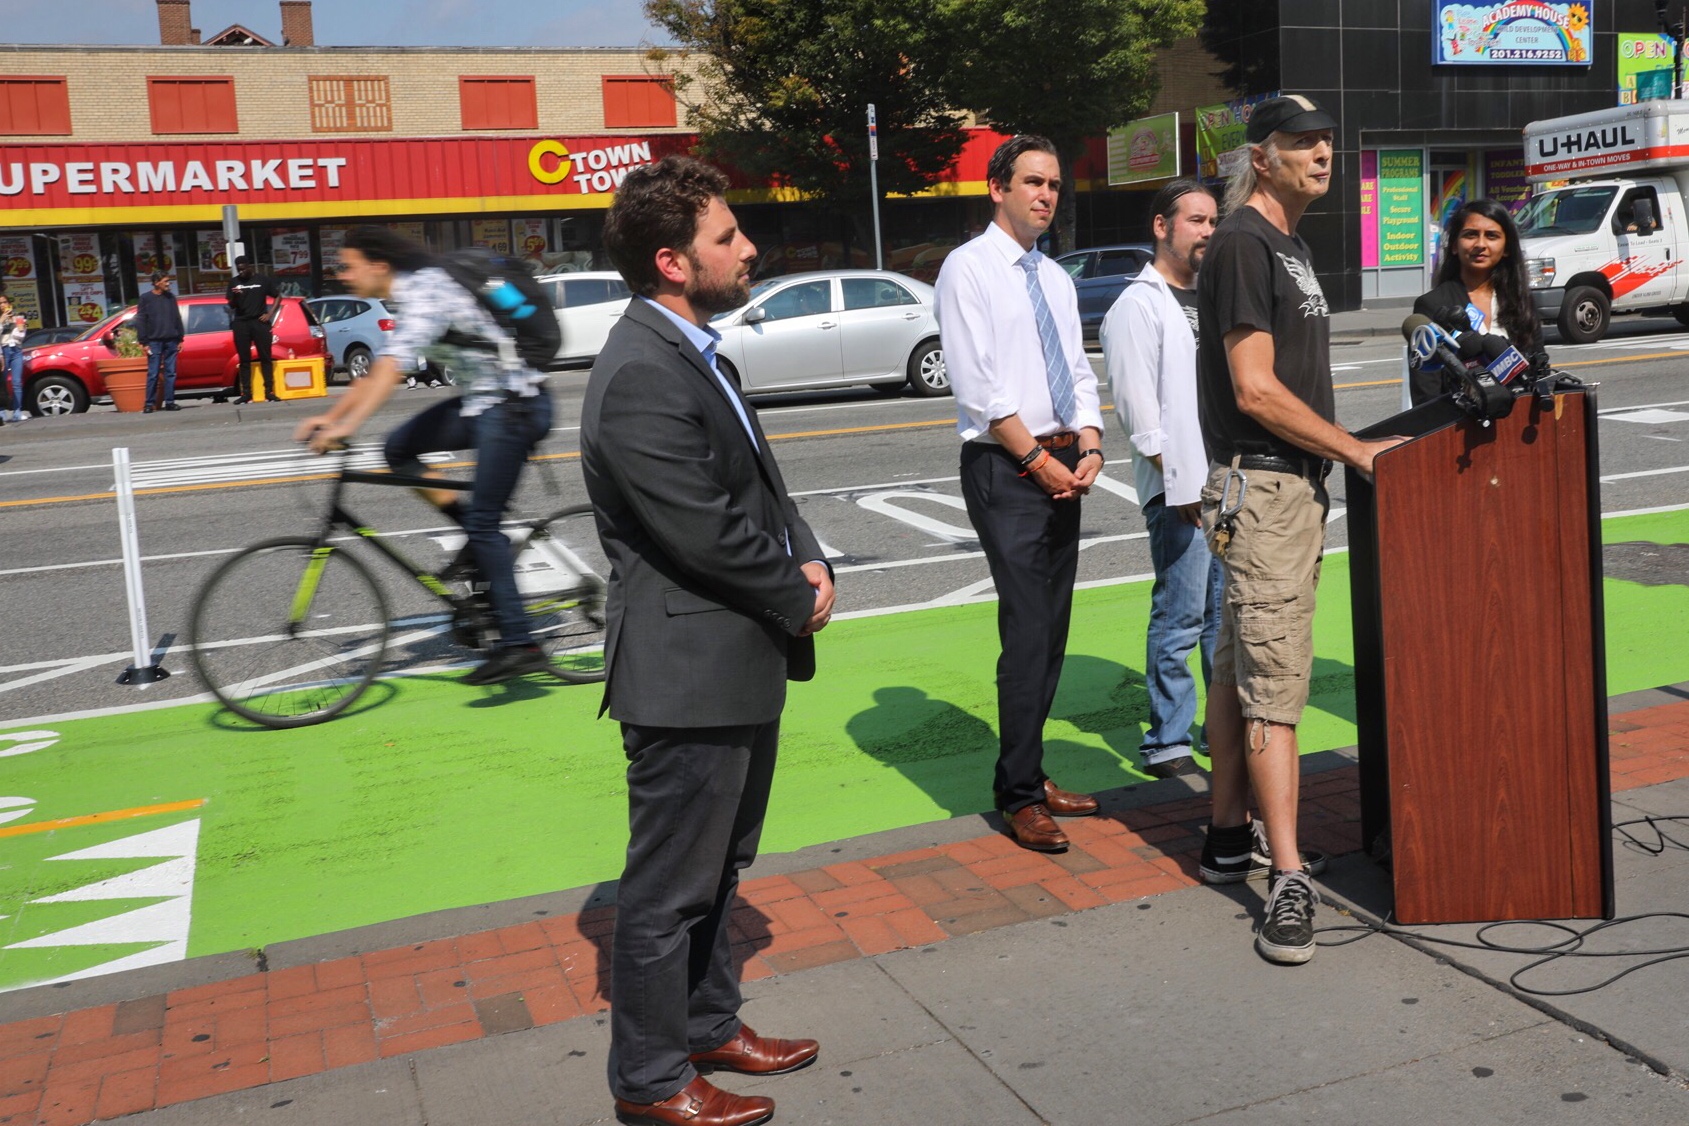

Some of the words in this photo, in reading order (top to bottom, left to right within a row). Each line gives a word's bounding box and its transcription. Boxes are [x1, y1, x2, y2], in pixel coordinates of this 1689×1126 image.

[1483, 5, 1533, 28] ACADEMY
[1534, 6, 1570, 29] HOUSE
[1515, 36, 1539, 44] CENTER
[1622, 40, 1667, 58] OPEN
[1491, 50, 1562, 59] 201.216.9252
[1539, 126, 1635, 158] U-HAUL
[569, 141, 652, 173] TOWN
[1382, 157, 1420, 167] SUMMER
[1543, 161, 1572, 172] ONE-WAY
[1578, 158, 1606, 167] IN-TOWN
[1607, 153, 1631, 163] MOVES
[1382, 168, 1419, 178] PROGRAMS
[1390, 205, 1412, 213] Secure
[1383, 216, 1419, 225] Playground
[1387, 232, 1415, 240] Indoor
[1383, 243, 1419, 251] Outdoor
[1384, 253, 1418, 262] Activity
